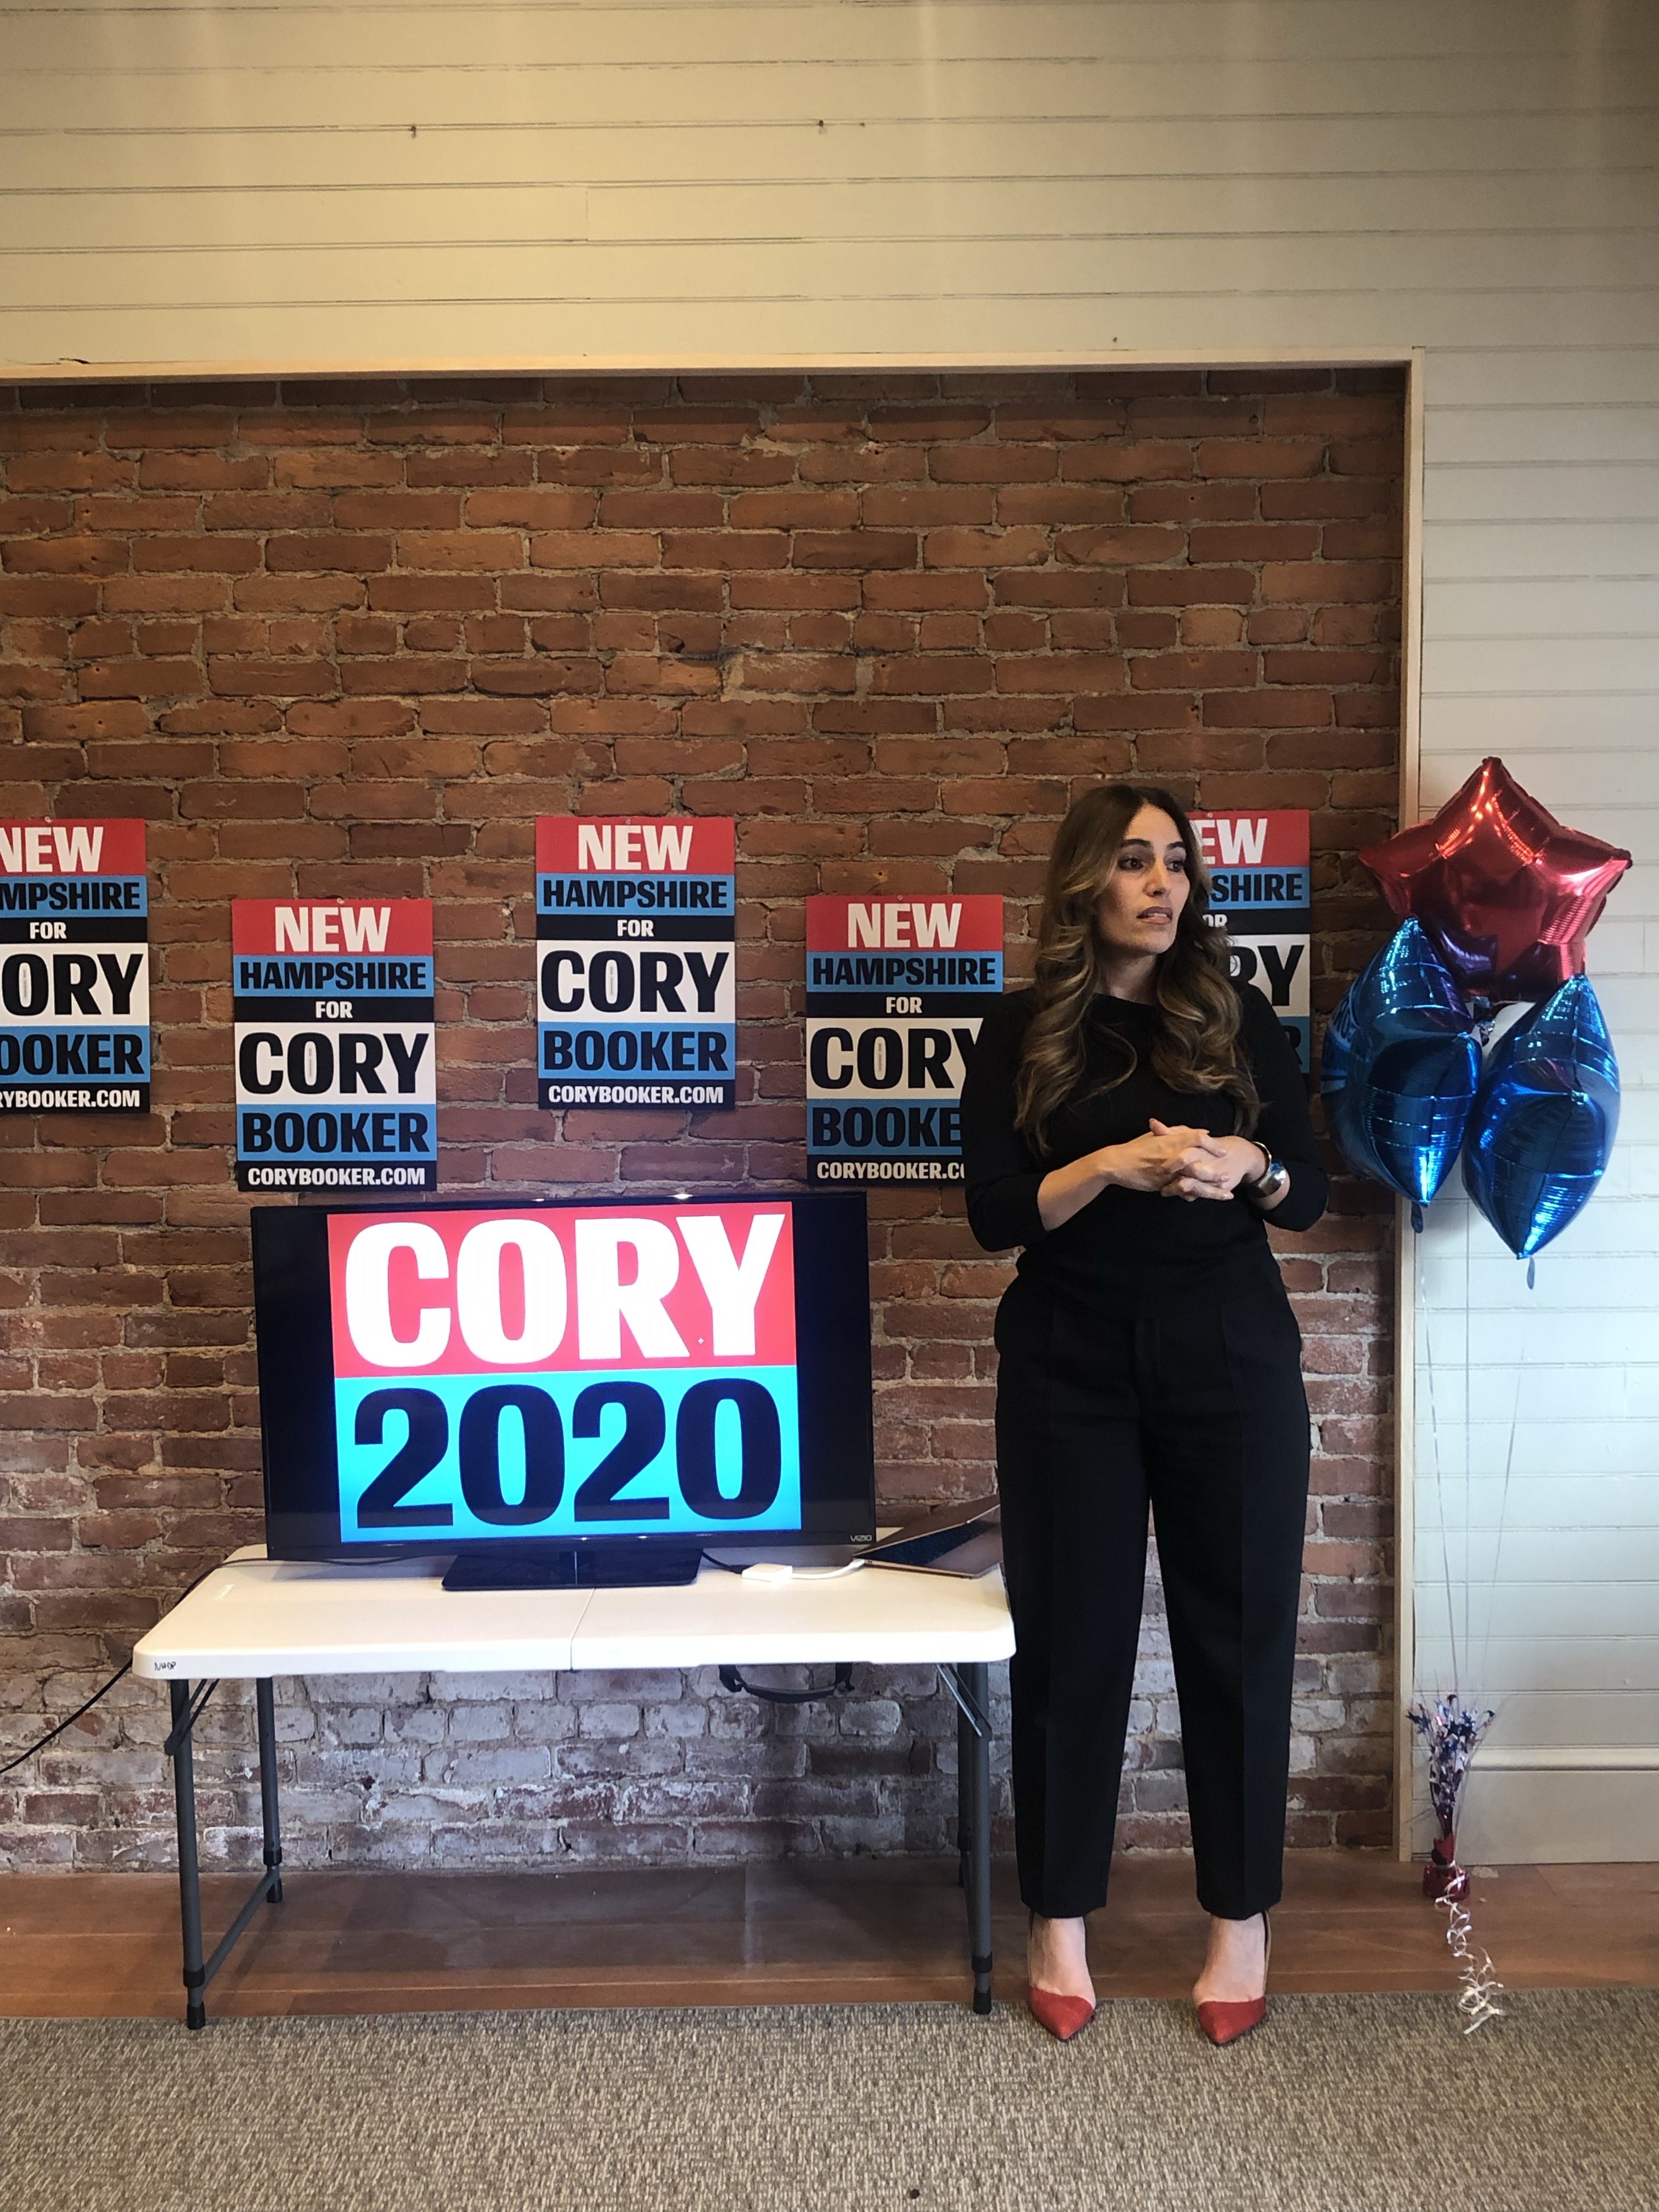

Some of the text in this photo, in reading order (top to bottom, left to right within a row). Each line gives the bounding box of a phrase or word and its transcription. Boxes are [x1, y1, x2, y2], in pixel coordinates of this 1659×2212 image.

[0, 827, 103, 872] NEW
[578, 825, 693, 871] NEW
[1189, 818, 1268, 865] EW
[0, 882, 140, 911] MPSHIRE
[544, 880, 727, 908] HAMPSHIRE
[1210, 873, 1302, 902] SHIRE
[30, 922, 66, 939] FOR
[275, 907, 391, 952] NEW
[617, 920, 654, 937] FOR
[848, 903, 962, 947] NEW
[2, 953, 144, 1016] ORY
[240, 962, 426, 990] HAMPSHIRE
[541, 950, 729, 1013] CORY
[812, 958, 996, 985] HAMPSHIRE
[315, 1001, 353, 1018] FOR
[886, 997, 922, 1014] FOR
[0, 1034, 144, 1075] OOKER
[239, 1032, 429, 1094] CORY
[544, 1030, 729, 1071] BOOKER
[0, 1090, 140, 1108] YBOOKER.COM
[549, 1085, 723, 1104] CORYBOOKER.COM
[242, 1112, 430, 1153] BOOKER
[812, 1107, 962, 1147] BOOKE
[248, 1168, 425, 1186] CORYBOOKER.COM
[817, 1162, 965, 1179] CORYBOOKER.C
[346, 1214, 785, 1367] CORY
[354, 1378, 782, 1528] 2020
